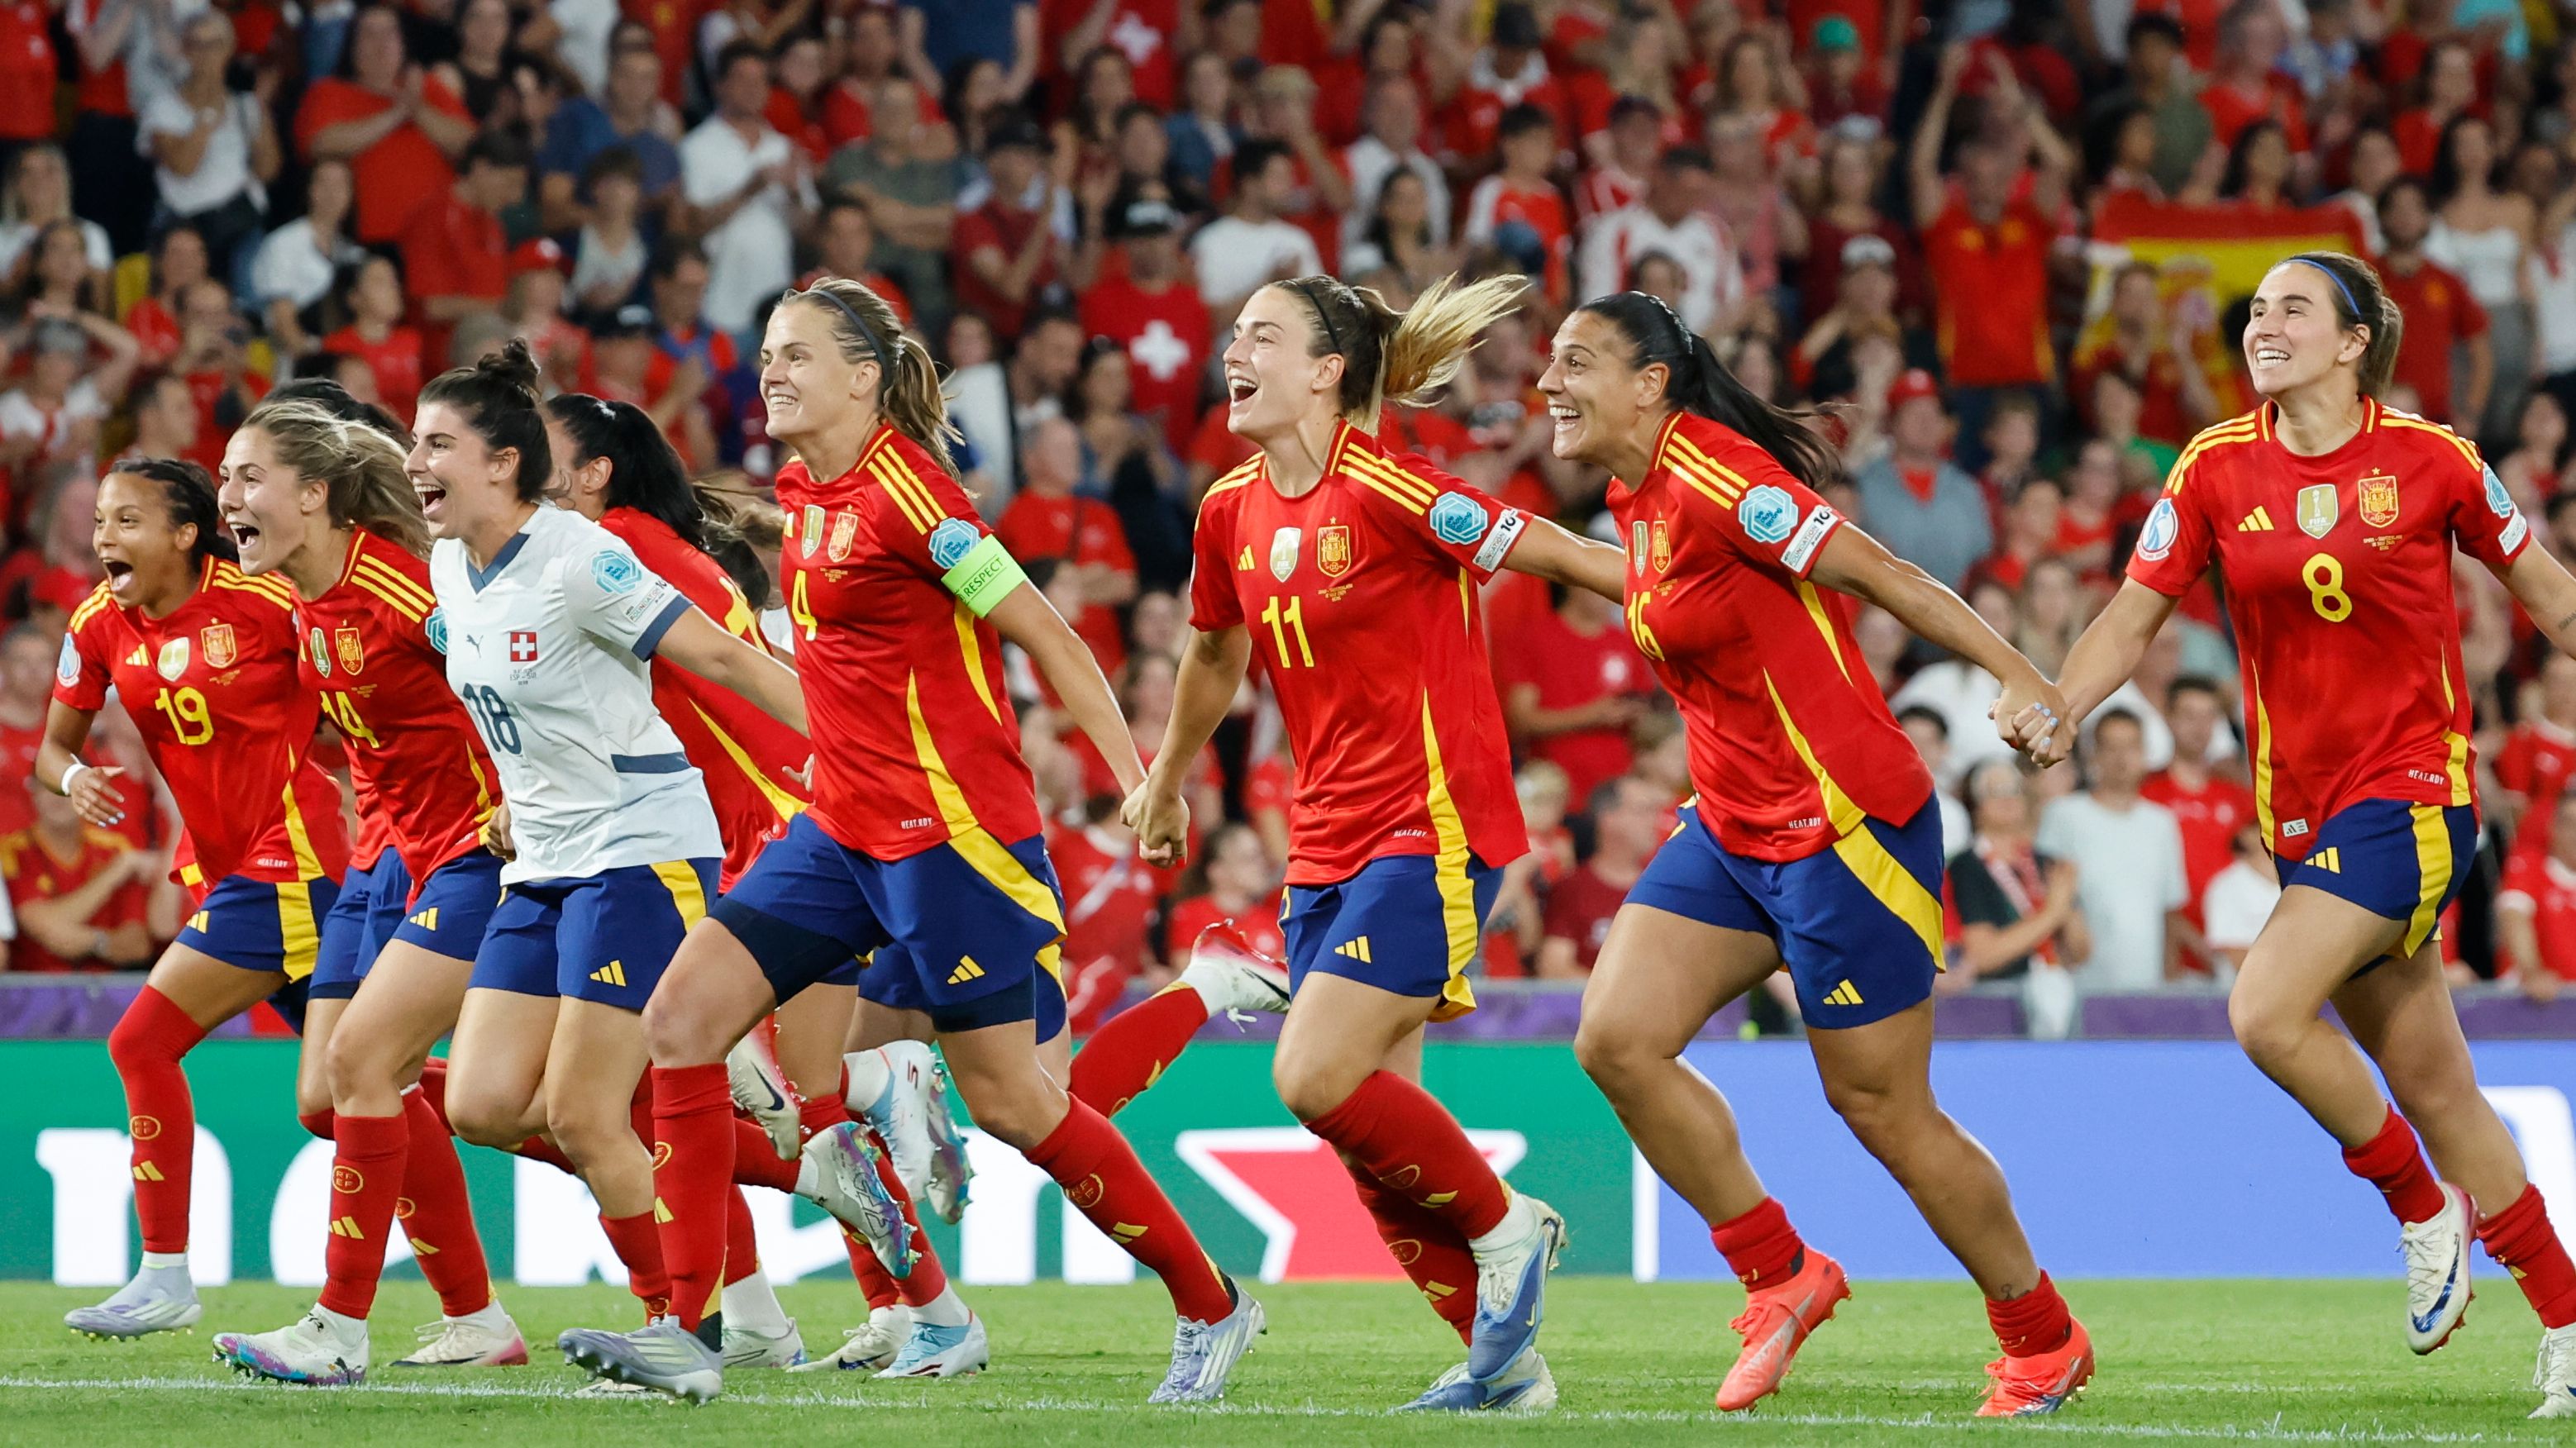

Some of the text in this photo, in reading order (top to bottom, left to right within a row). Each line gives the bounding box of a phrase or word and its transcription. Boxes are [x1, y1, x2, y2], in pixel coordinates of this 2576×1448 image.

[792, 569, 818, 641] 4
[963, 557, 1004, 597] RESPECT
[2302, 552, 2353, 623] 8
[1262, 596, 1314, 668] 11
[1628, 592, 1665, 661] 16
[155, 687, 214, 745] 19
[320, 690, 379, 749] 14
[463, 683, 522, 755] 18
[2408, 769, 2445, 785] HEAT.RDY
[901, 817, 932, 830] HEAT.RDY
[1788, 817, 1821, 829] HEAT.RDY
